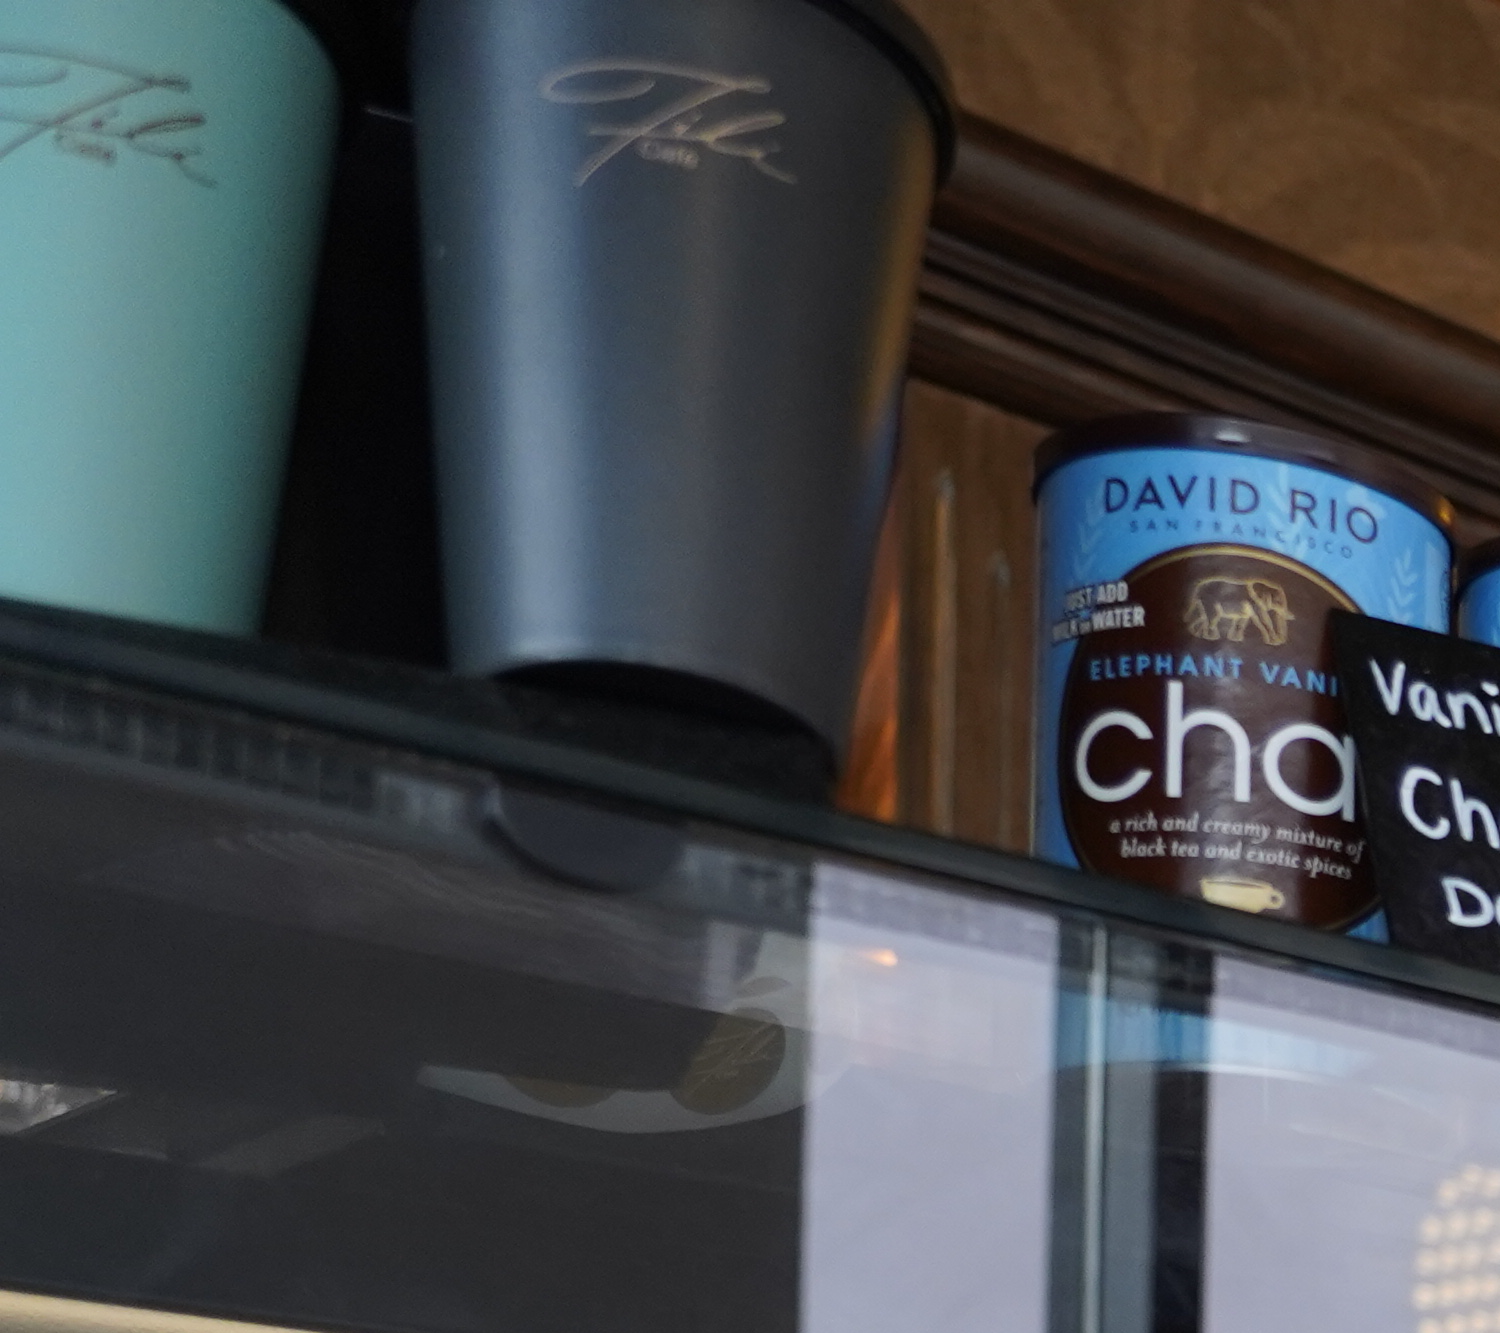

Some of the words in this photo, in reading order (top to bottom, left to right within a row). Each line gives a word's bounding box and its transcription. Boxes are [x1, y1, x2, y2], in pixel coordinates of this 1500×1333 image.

[1104, 475, 1261, 514] DAVID
[1289, 489, 1378, 544] RIO
[1129, 519, 1179, 533] SAN
[1194, 520, 1353, 559] FRANCISCO
[1096, 581, 1129, 604] ADD
[1091, 605, 1146, 631] WATER
[1090, 654, 1244, 681] ELEPHANT
[1259, 661, 1338, 697] VANI
[1076, 680, 1356, 822] cha
[1119, 837, 1168, 858] black
[1171, 841, 1200, 858] tea
[1204, 841, 1242, 860] and
[1246, 848, 1301, 870] exotic
[1303, 857, 1352, 880] spices
[1124, 811, 1158, 833] rich
[1162, 812, 1199, 834] and
[1203, 817, 1271, 845] creamy
[1276, 825, 1343, 851] mixture
[1346, 839, 1368, 864] of
